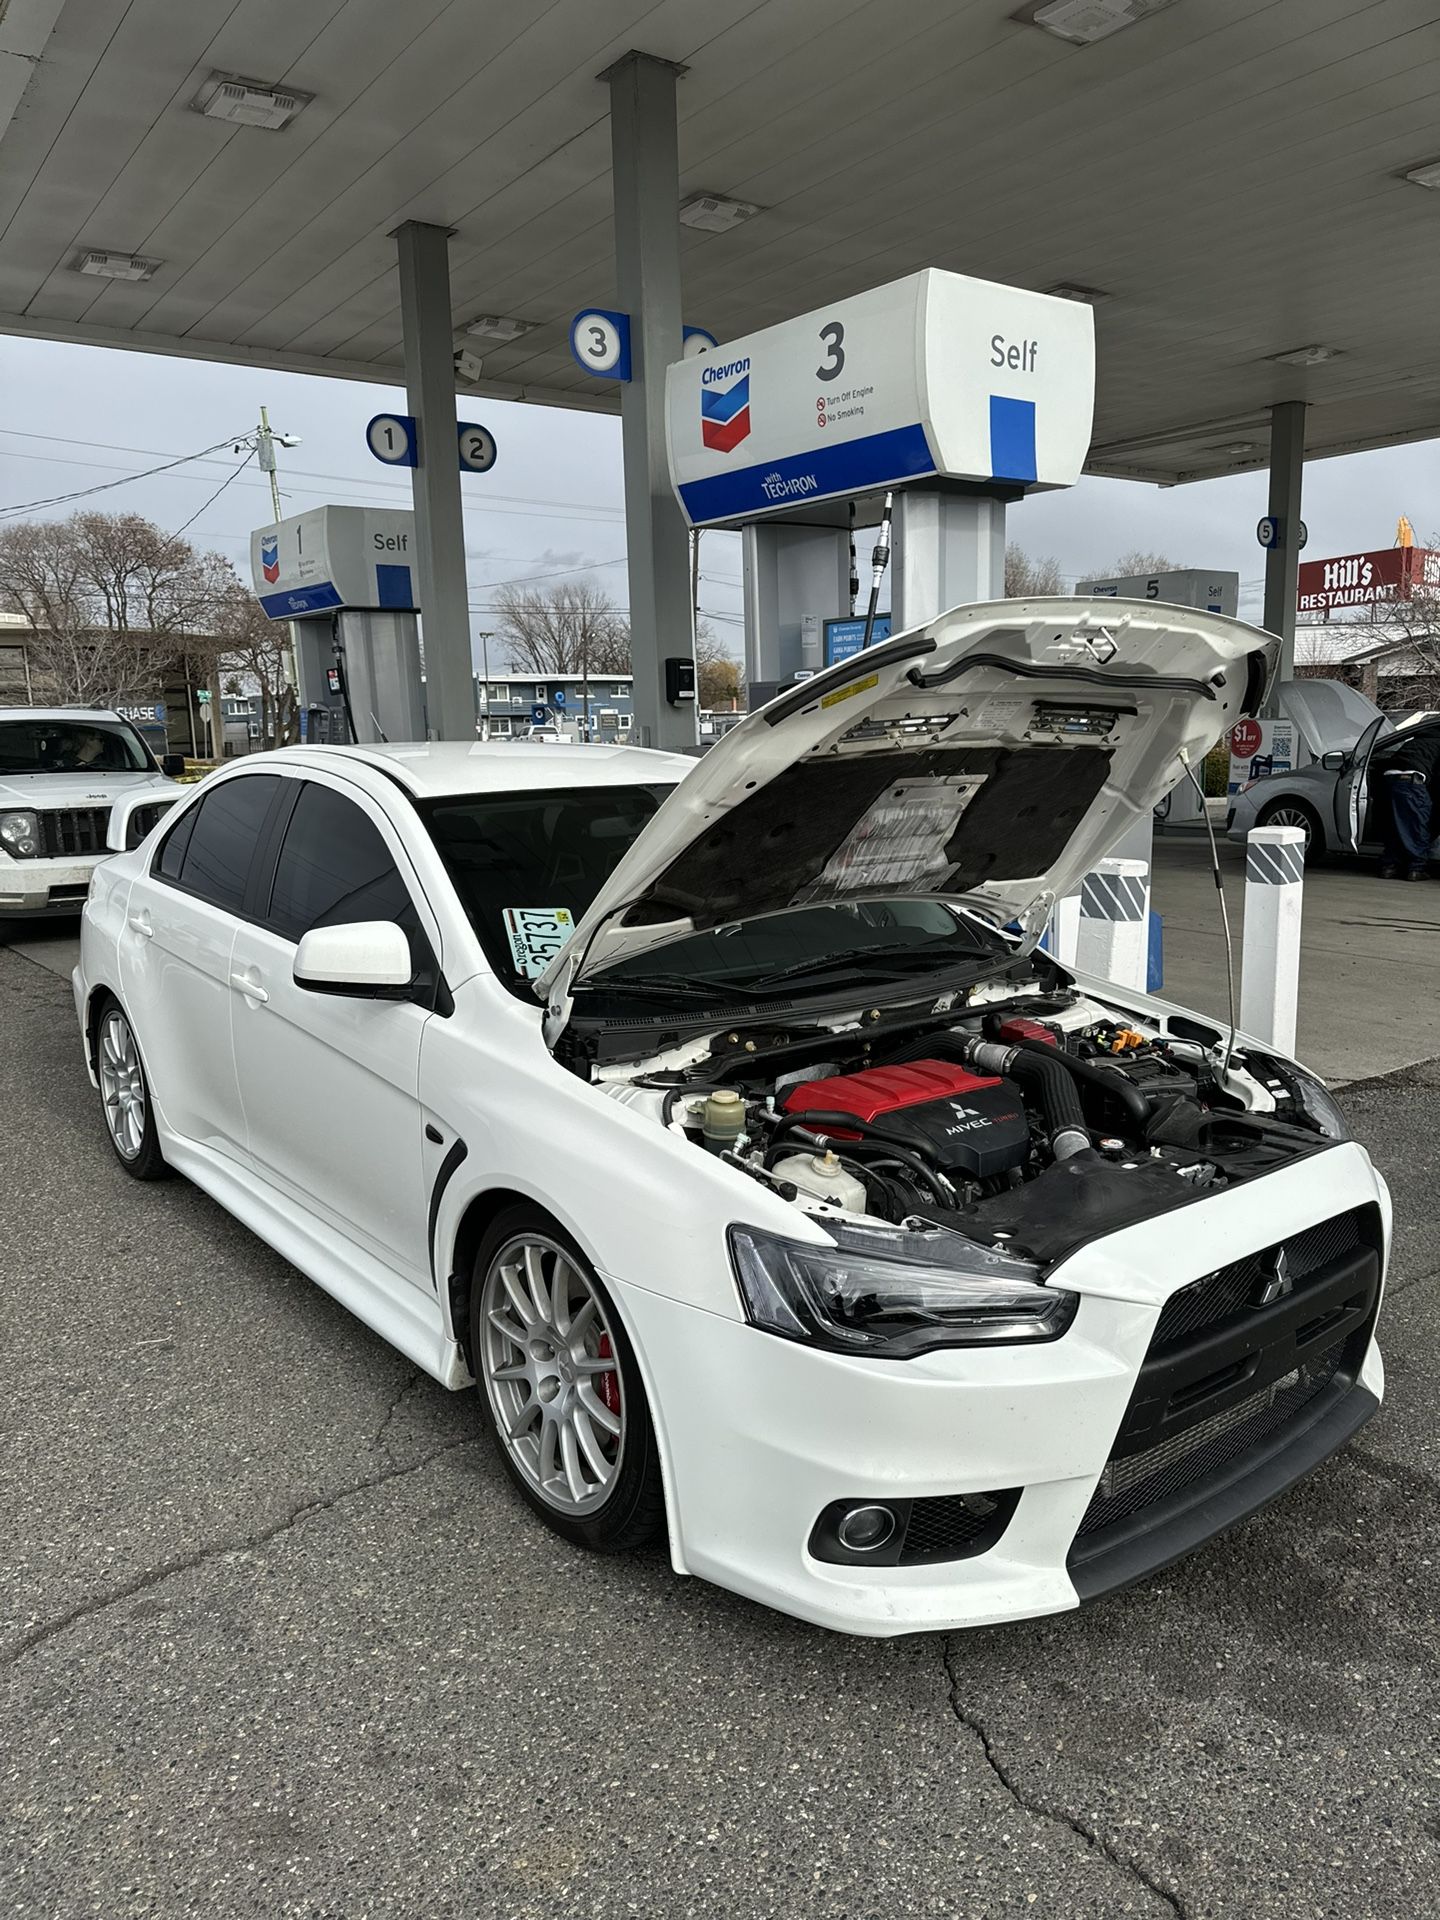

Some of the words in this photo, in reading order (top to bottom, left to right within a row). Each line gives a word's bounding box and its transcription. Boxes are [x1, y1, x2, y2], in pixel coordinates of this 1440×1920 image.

[588, 327, 607, 357] 3
[815, 321, 845, 382] 3
[990, 334, 1038, 373] Self
[702, 357, 750, 385] Chevron
[826, 395, 841, 406] Turn
[841, 391, 851, 402] Off
[852, 385, 874, 399] Engine
[827, 413, 837, 422] No
[837, 406, 865, 420] Smoking
[383, 427, 394, 450] 1
[469, 437, 484, 460] 2
[761, 474, 818, 499] TECHRON
[764, 472, 782, 484] with
[296, 524, 303, 555] 1
[374, 534, 408, 551] Self
[1262, 525, 1270, 539] 5
[1323, 556, 1373, 590] Hill's
[1093, 585, 1118, 594] Chevron
[1146, 579, 1159, 599] 5
[1208, 586, 1223, 597] Self
[1300, 583, 1398, 609] RESTAURANT
[116, 707, 156, 720] CHASE
[1234, 724, 1248, 742] $1
[513, 934, 528, 965] Oregon
[945, 1117, 993, 1136] MIVEC
